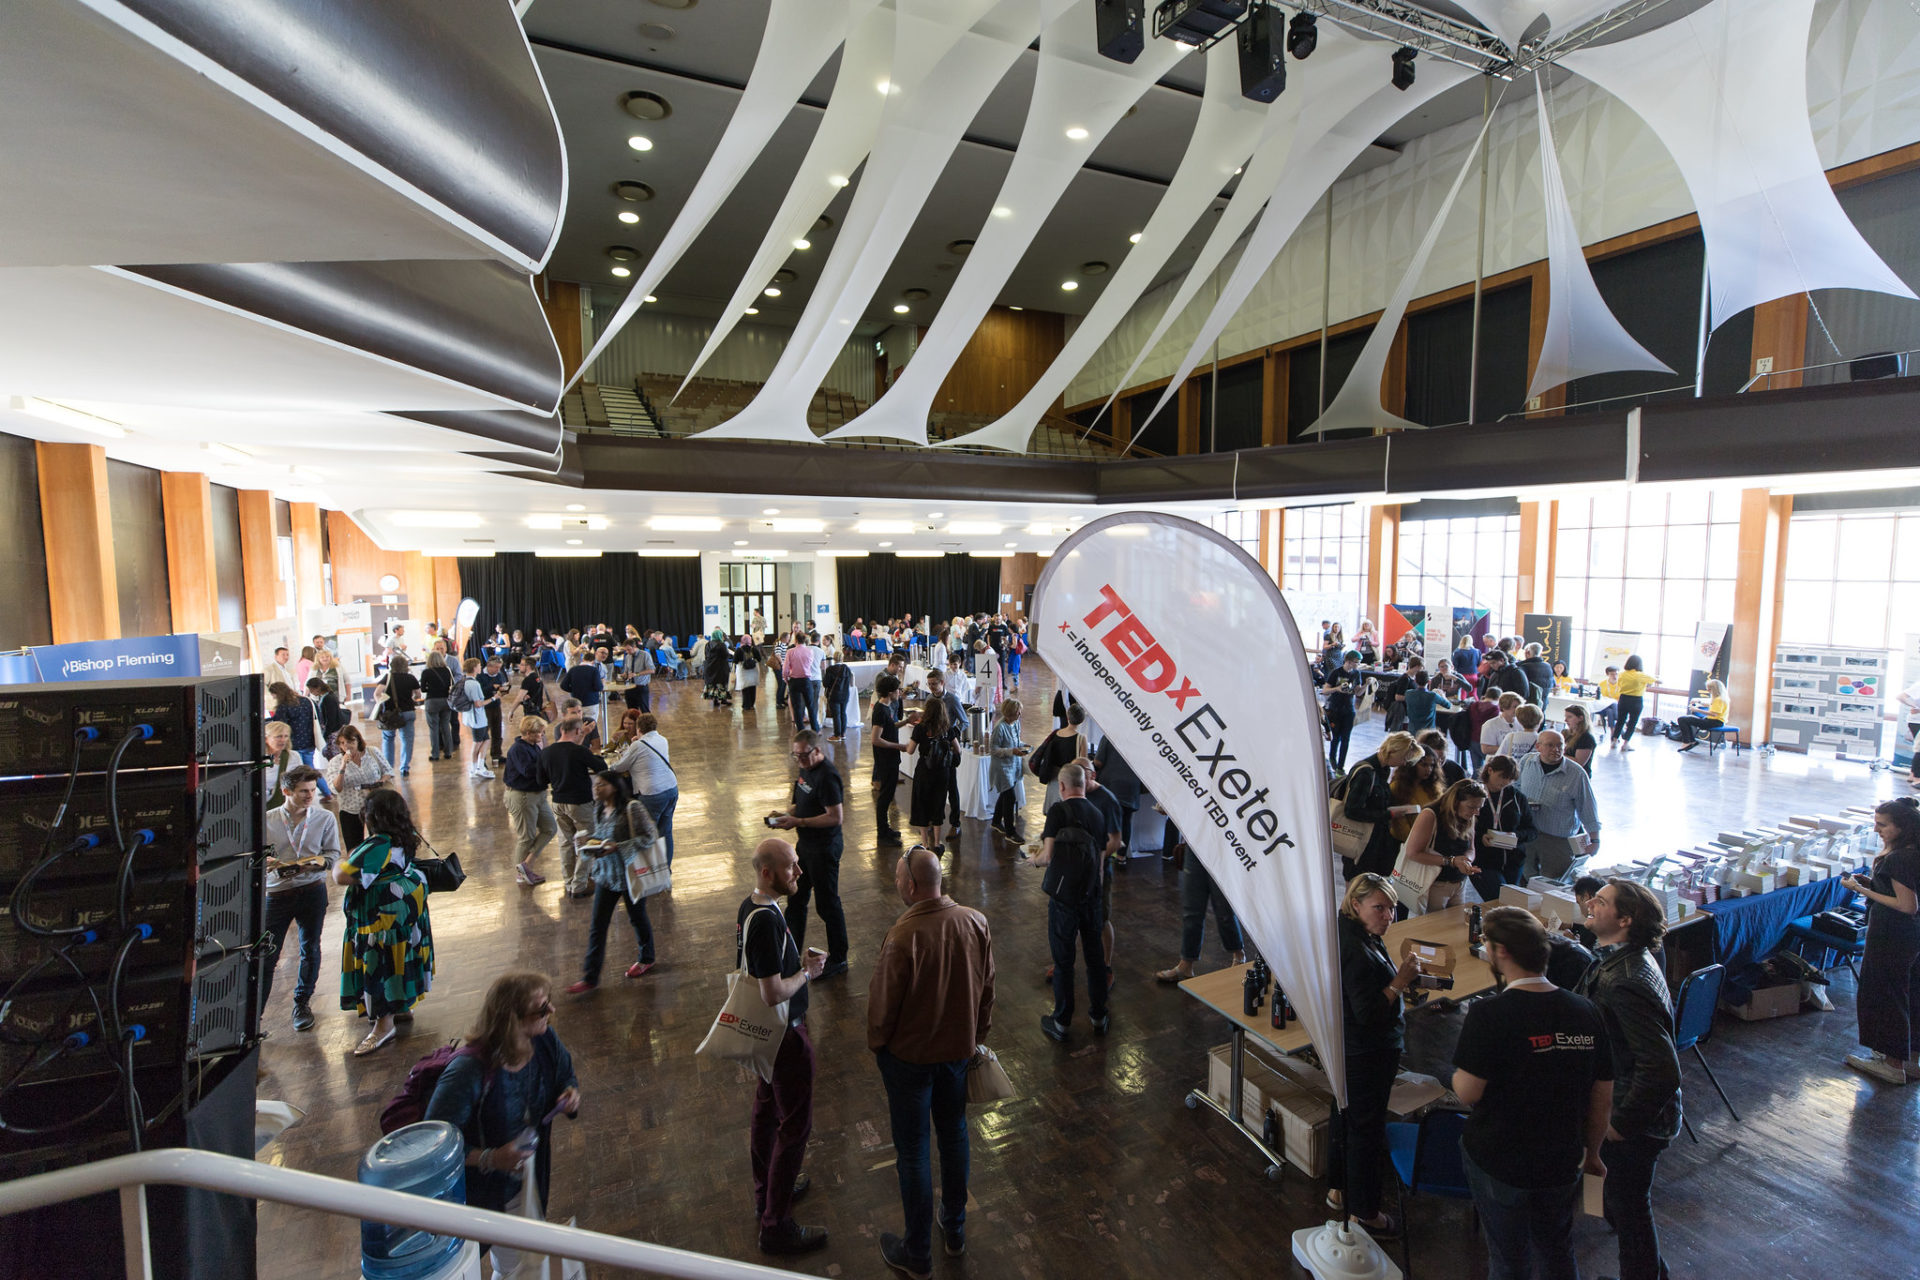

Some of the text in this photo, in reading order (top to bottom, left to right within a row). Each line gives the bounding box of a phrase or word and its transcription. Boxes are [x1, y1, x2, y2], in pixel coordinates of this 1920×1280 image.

[70, 652, 174, 673] Bishop Fleming
[980, 659, 992, 678] 4
[1074, 637, 1154, 732] independently
[1152, 732, 1208, 799] organized
[1203, 796, 1229, 828] TED
[1224, 830, 1258, 872] event
